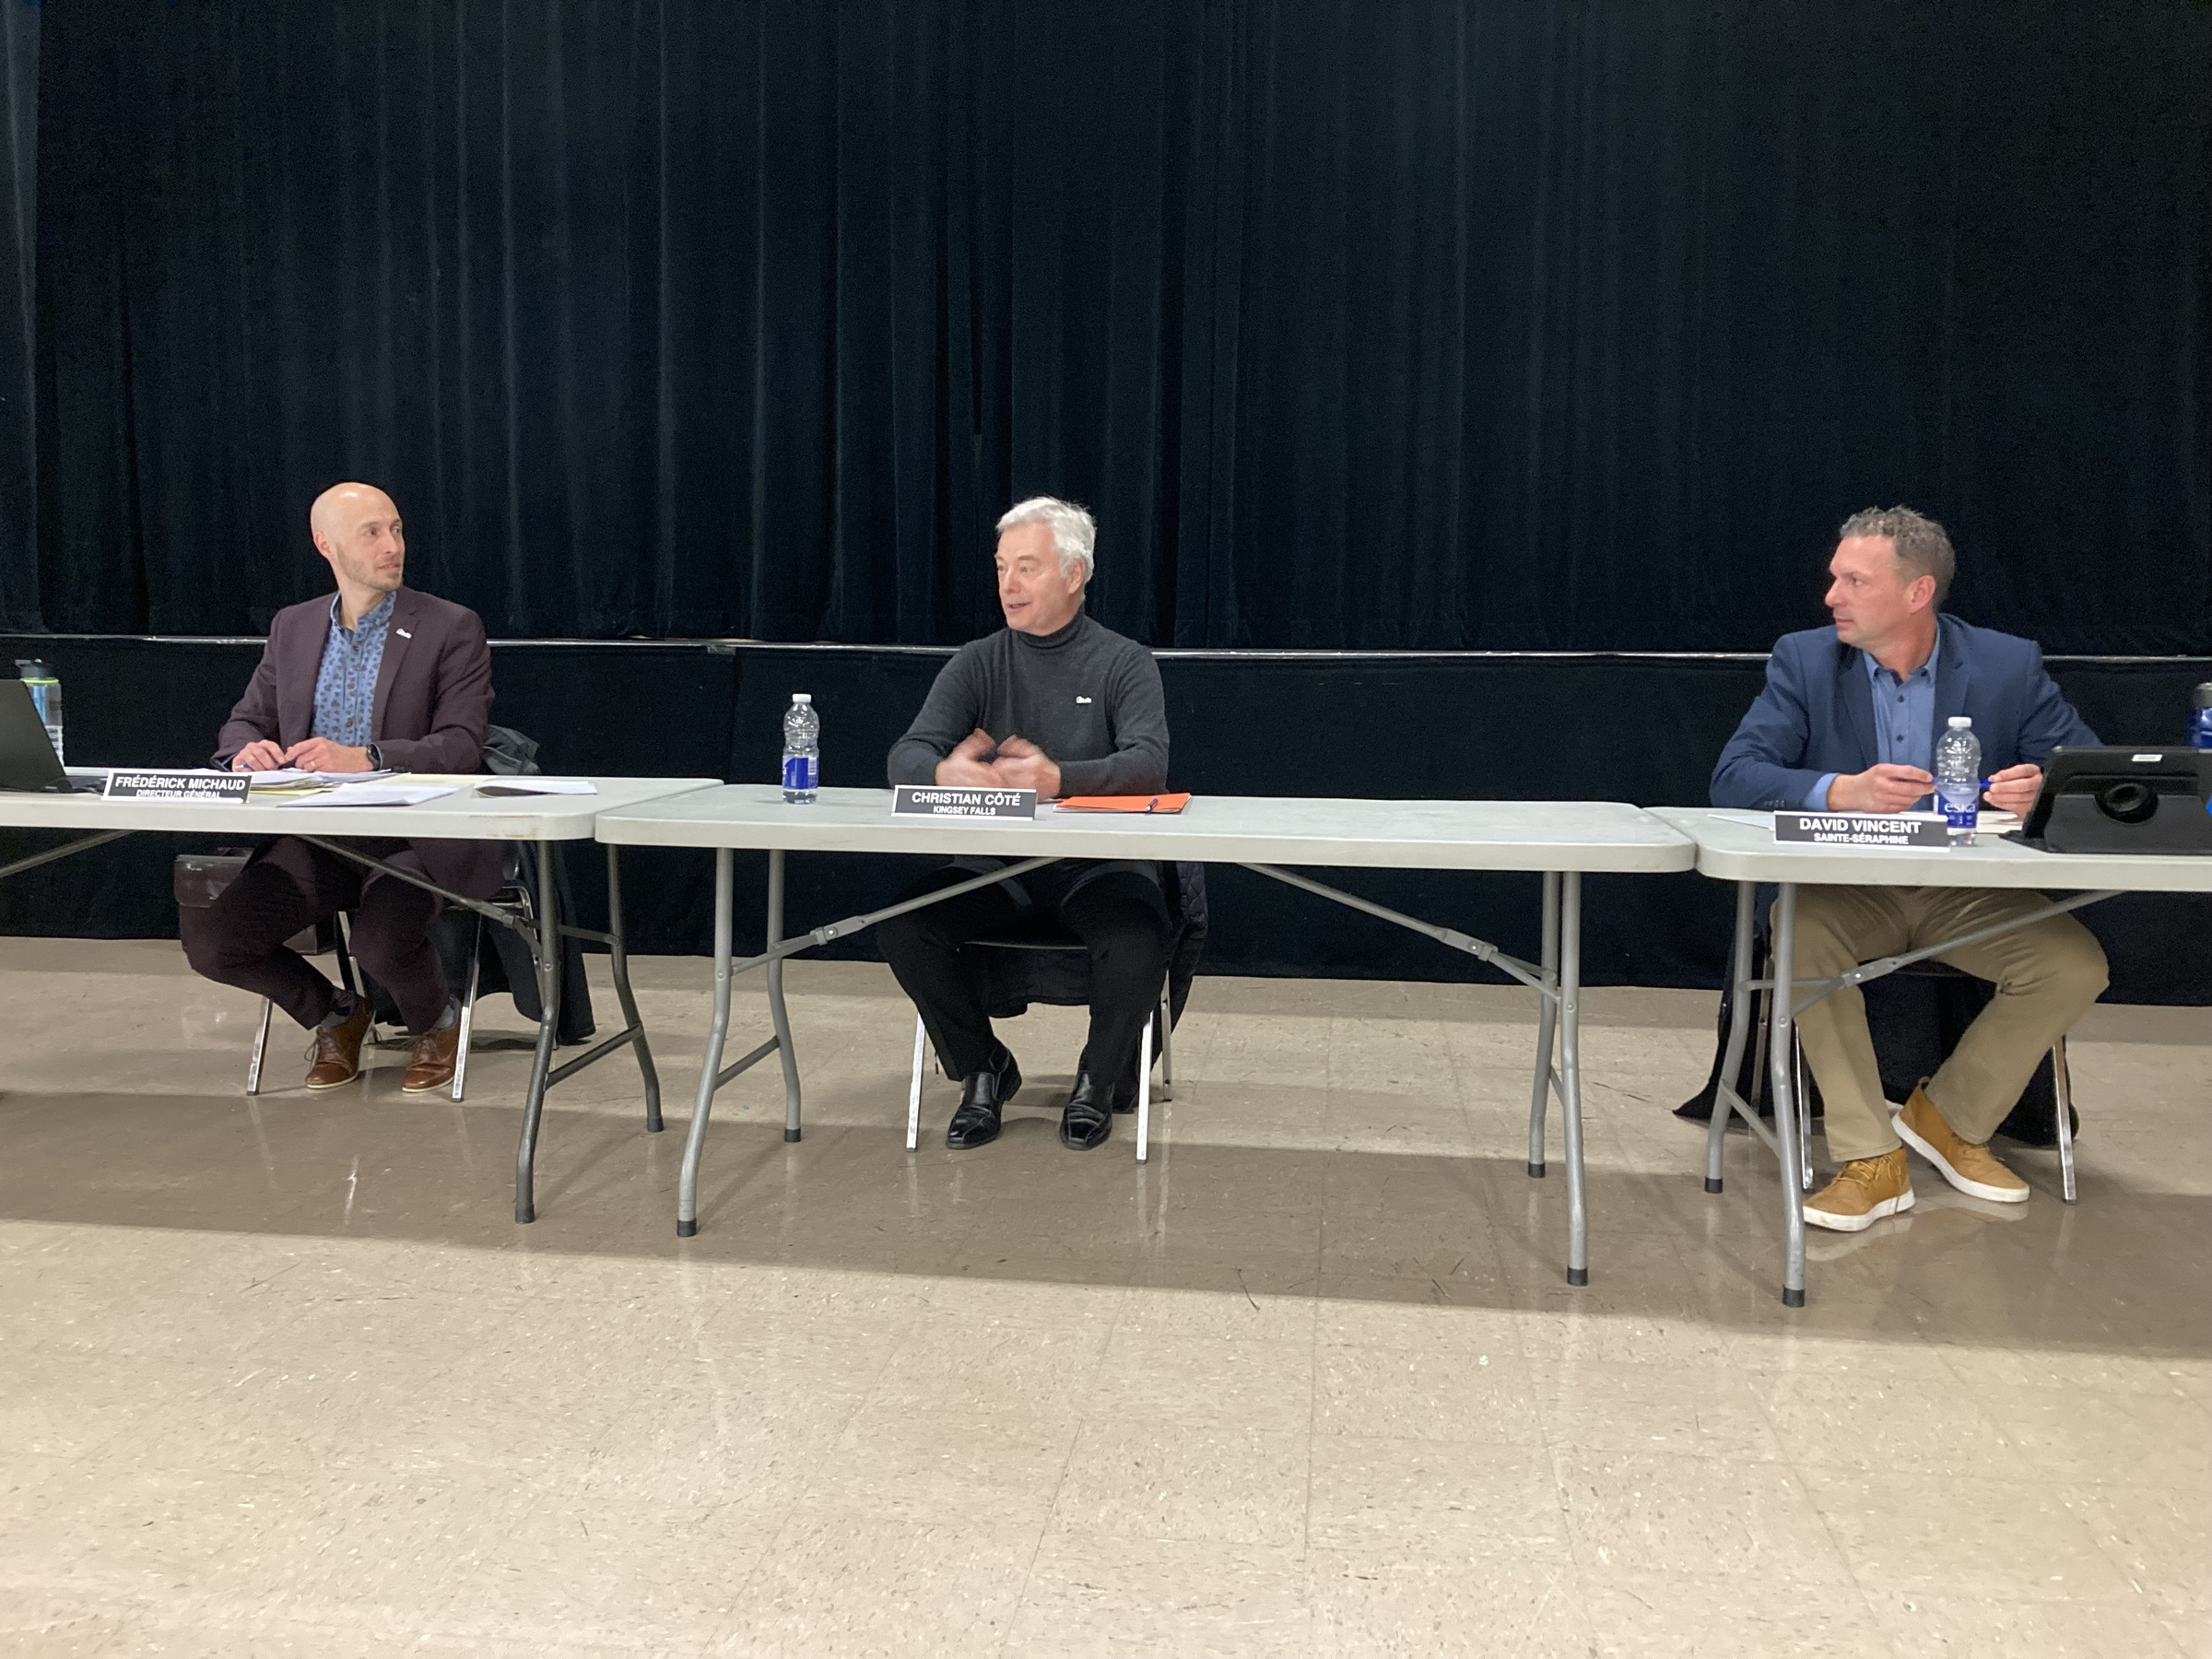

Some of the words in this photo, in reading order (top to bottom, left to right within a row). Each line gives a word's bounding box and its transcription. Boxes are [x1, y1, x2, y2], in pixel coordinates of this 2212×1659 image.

[115, 775, 186, 789] FRÉDÉRICK
[188, 778, 245, 790] MICHAUD
[136, 789, 182, 798] DIRECTEUR
[183, 790, 220, 798] GÉNÉRAL
[912, 792, 982, 805] CHRISTIAN
[984, 793, 1021, 806] CÔTÉ
[934, 806, 969, 815] KINGSEY
[970, 806, 996, 816] FALLS
[1799, 818, 1849, 831] DAVID
[1852, 820, 1922, 833] VINCENT
[1814, 832, 1909, 844] SAINTE-SÉRAPHINE
